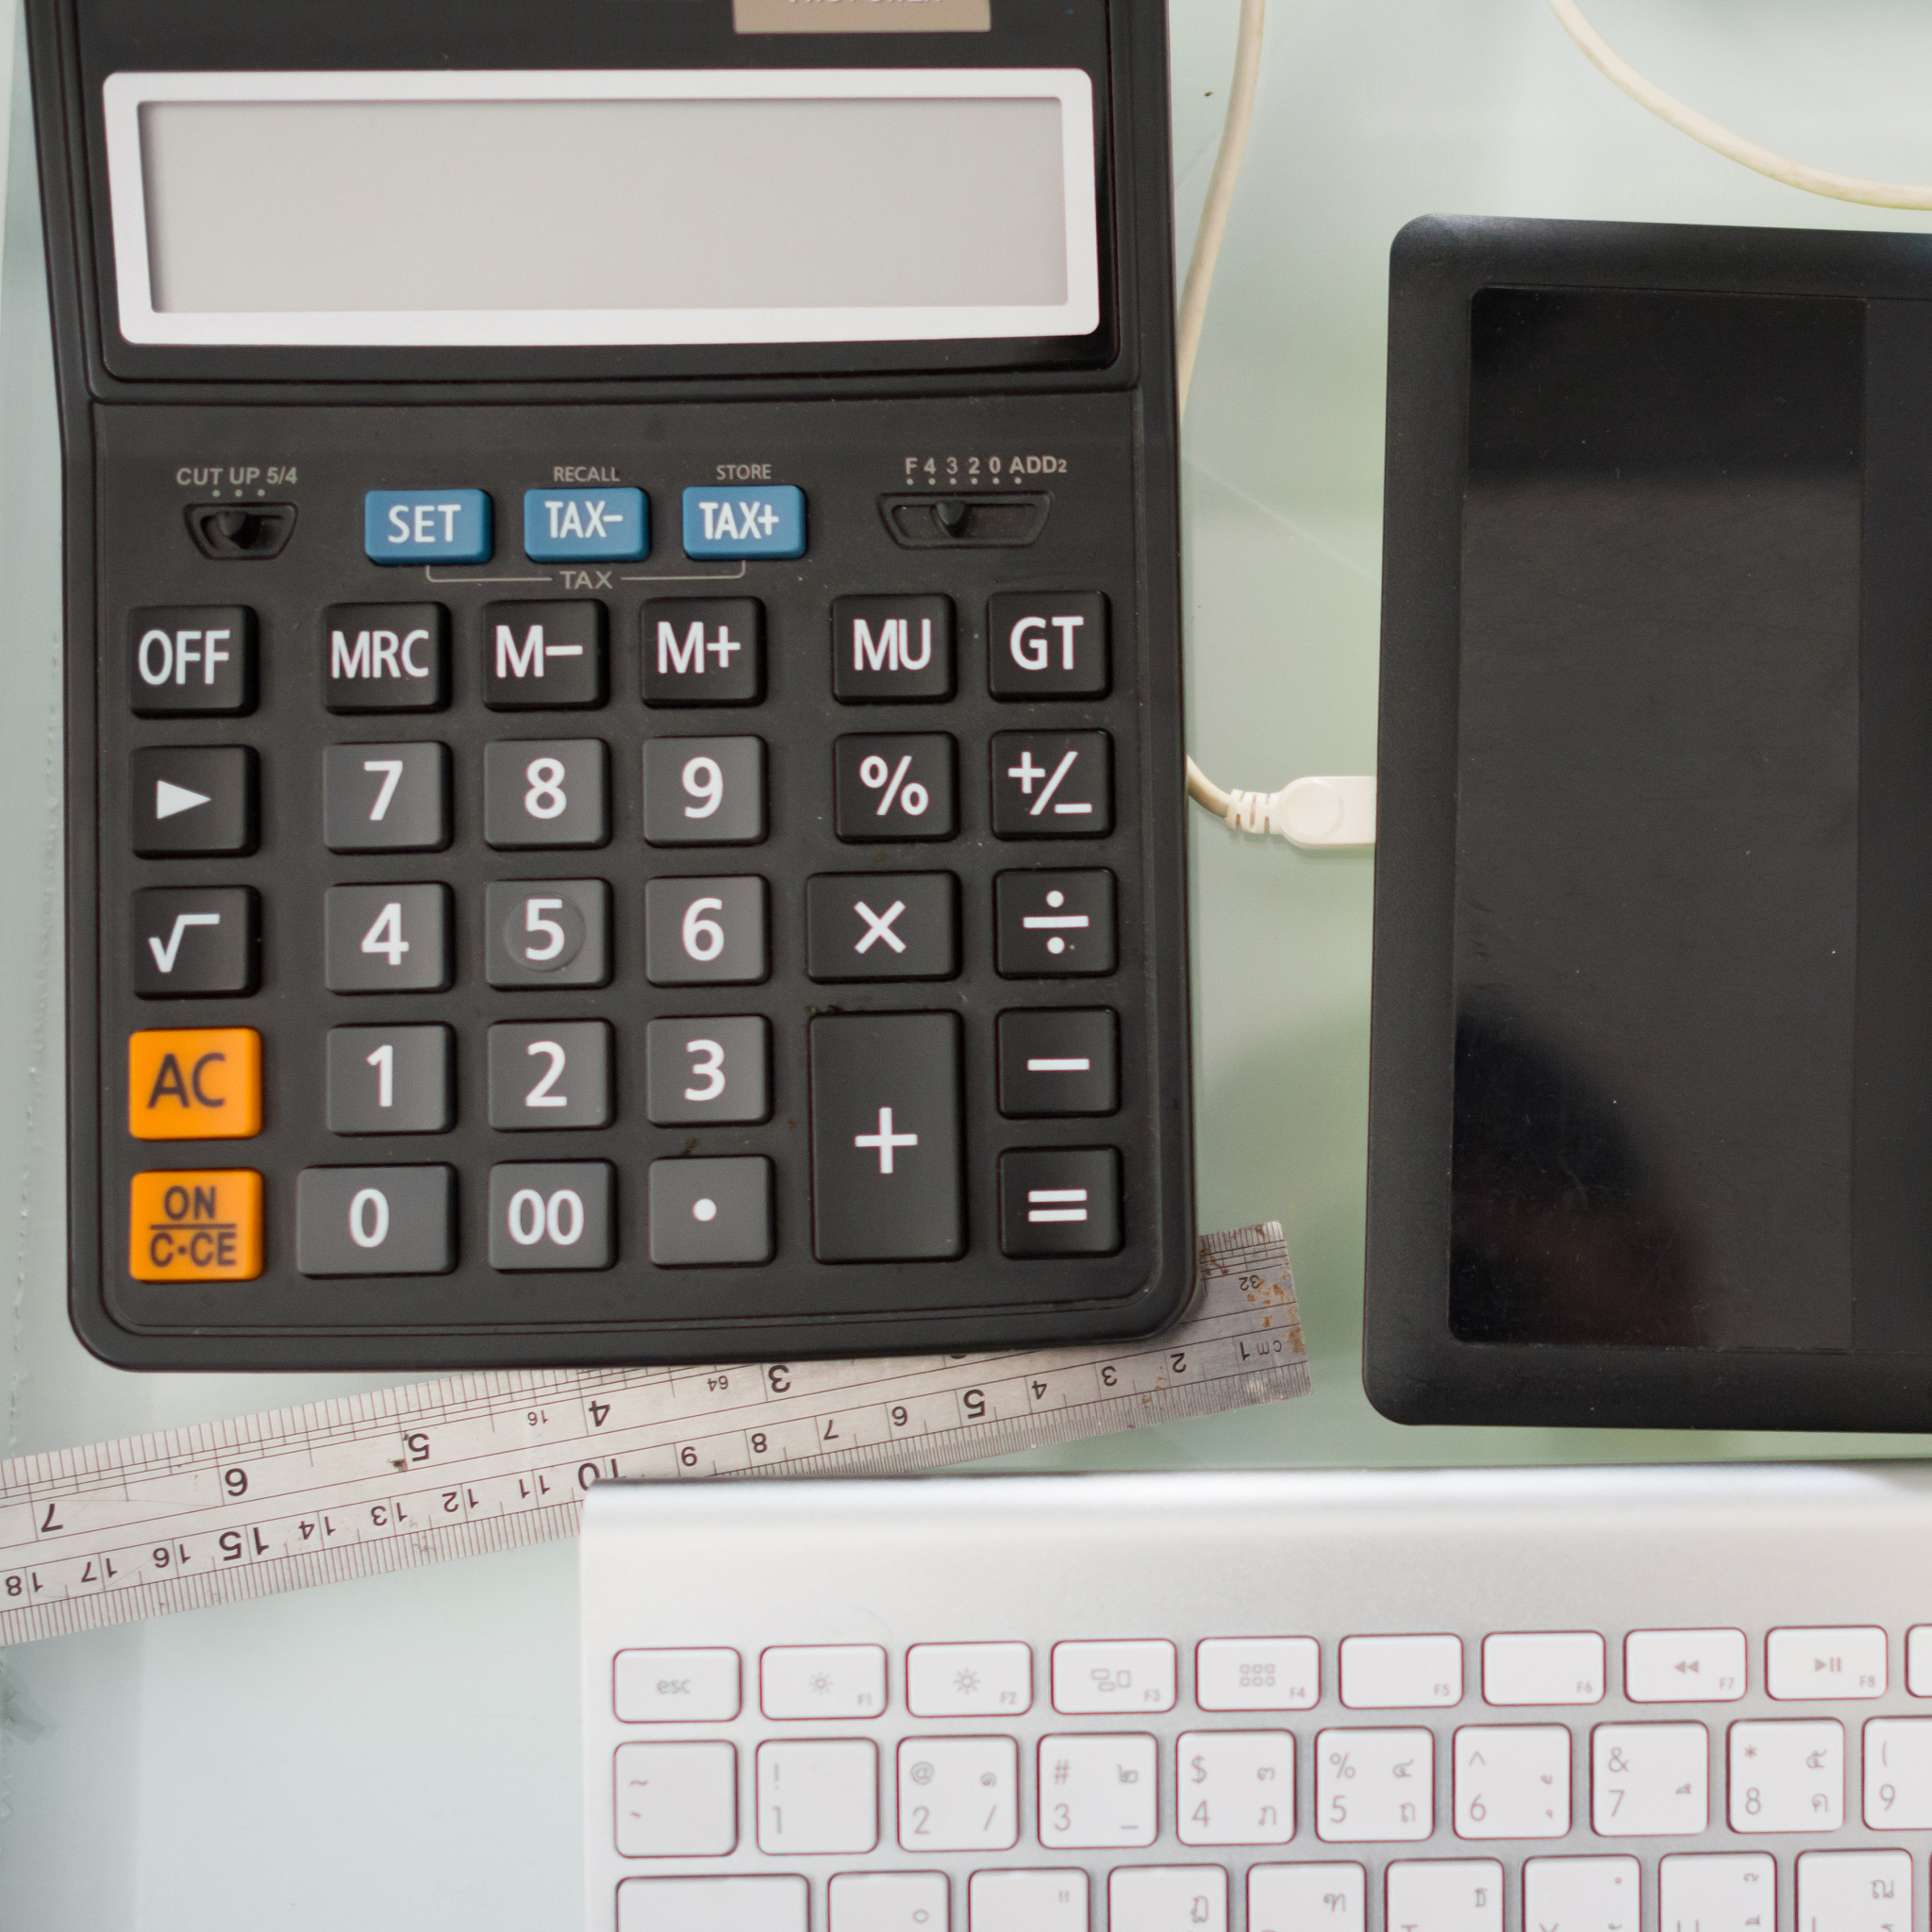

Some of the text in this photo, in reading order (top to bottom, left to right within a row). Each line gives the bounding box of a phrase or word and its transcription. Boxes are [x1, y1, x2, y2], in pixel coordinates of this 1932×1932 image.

[176, 466, 297, 485] CUT UP 5/4
[553, 466, 620, 482] RECALL
[716, 464, 772, 480] STORE
[906, 458, 918, 475] F
[924, 458, 936, 475] 4
[947, 458, 958, 474] 3
[969, 458, 980, 474] 2
[989, 458, 1001, 474] 0
[388, 503, 461, 543] SET
[699, 501, 779, 540] TAX+
[559, 570, 612, 590] TAX
[331, 629, 429, 679] MRC
[657, 621, 741, 674] M+
[853, 618, 932, 672] MU
[1009, 615, 1084, 671] GT
[138, 629, 230, 686] OFF
[363, 759, 403, 821] 7
[525, 757, 567, 819] 8
[681, 757, 724, 819] 9
[859, 755, 929, 816] %
[361, 903, 409, 965] 4
[525, 898, 565, 960] 5
[681, 897, 724, 961] 6
[147, 1052, 225, 1108] AC
[366, 1044, 393, 1108] 1
[525, 1041, 567, 1108] 2
[684, 1039, 725, 1101] 3
[163, 1185, 216, 1221] ON
[349, 1189, 390, 1248] 0
[508, 1189, 584, 1245] 00
[1239, 1274, 1261, 1291] 32
[1240, 1341, 1250, 1361] 1
[1257, 1340, 1282, 1356] cm
[1101, 1366, 1118, 1387] 3
[1171, 1352, 1187, 1374] 2
[708, 1375, 729, 1391] 64
[1032, 1380, 1047, 1400] 4
[527, 1409, 549, 1426] 16
[891, 1407, 908, 1426] 6
[963, 1390, 986, 1419] 5
[751, 1433, 767, 1453] 8
[823, 1420, 840, 1441] 7
[41, 1364, 791, 1533] 3 4 5 6 7
[680, 1446, 697, 1466] 9
[519, 1474, 550, 1499] 11
[371, 1502, 408, 1526] 13
[441, 1489, 479, 1513] 12
[299, 1515, 336, 1540] 14
[153, 1543, 191, 1568] 16
[219, 1527, 270, 1561] 15
[81, 1557, 118, 1583] 17
[5, 1572, 43, 1597] 18
[657, 1679, 691, 1695] esc
[1290, 1687, 1306, 1699] F4
[1434, 1683, 1450, 1696] F5
[1576, 1681, 1592, 1694] F6
[1719, 1677, 1735, 1690] F7
[1859, 1675, 1875, 1689] F8
[857, 1693, 873, 1707] F1
[1000, 1691, 1017, 1705] F2
[1144, 1690, 1160, 1703] F3
[1191, 1756, 1208, 1784] $
[1607, 1746, 1629, 1773] &
[1330, 1795, 1347, 1824] 5
[1469, 1793, 1487, 1822] 6
[1608, 1790, 1624, 1817] 7
[1745, 1788, 1761, 1815] 8
[1879, 1784, 1896, 1811] 9
[773, 1807, 782, 1835] 1
[912, 1806, 930, 1835] 2
[1055, 1804, 1072, 1831] 3
[1191, 1800, 1210, 1827] 4
